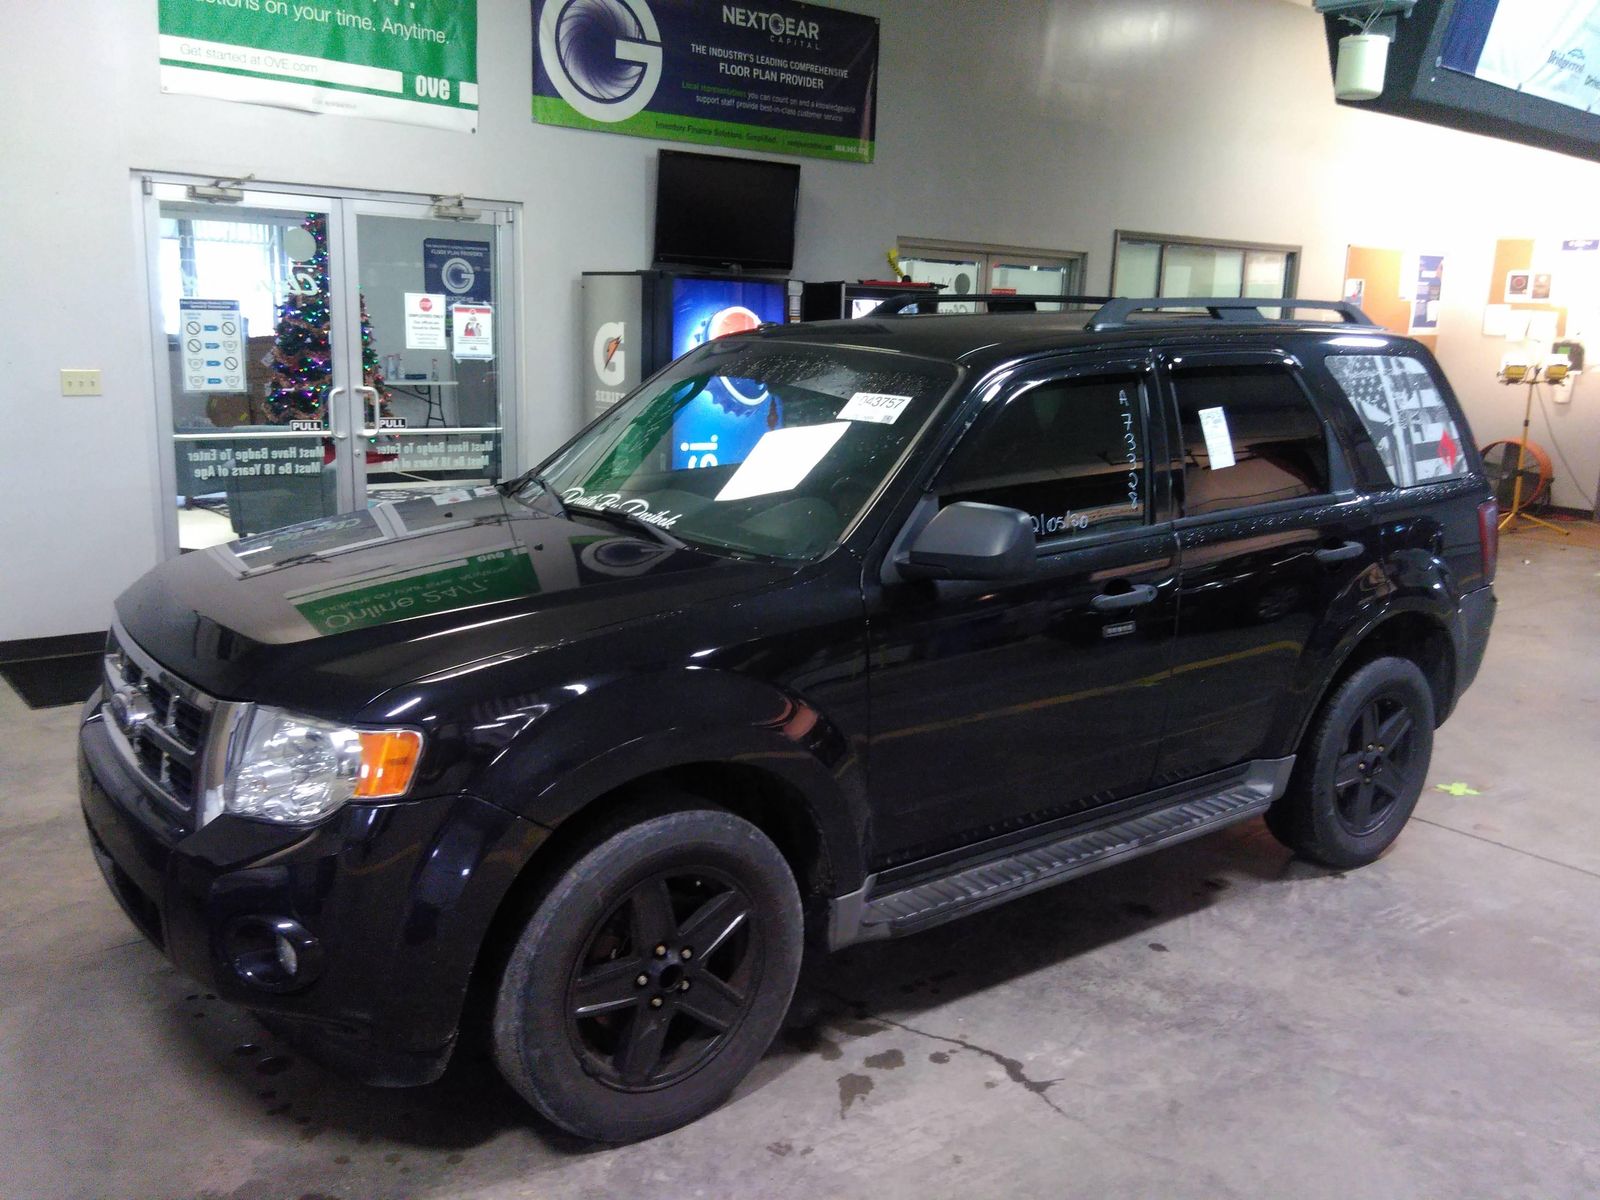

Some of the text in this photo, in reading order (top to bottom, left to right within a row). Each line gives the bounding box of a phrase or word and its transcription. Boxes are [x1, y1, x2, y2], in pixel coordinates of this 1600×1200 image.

[264, 0, 288, 15] on
[292, 4, 332, 23] your
[336, 9, 376, 32] time.
[381, 17, 450, 44] Anytime.
[722, 5, 820, 40] NEXTGEAR
[770, 35, 820, 50] CAPITAL
[180, 43, 201, 56] Get
[205, 48, 247, 64] started
[250, 54, 261, 65] at
[691, 43, 849, 79] THE INDUSTRY'S LEADING COMPREHENSIVE
[719, 62, 824, 89] FLOOR PLAN PROVIDER
[415, 75, 451, 100] ove
[747, 92, 759, 100] you
[695, 95, 720, 105] support
[721, 98, 736, 106] staff
[736, 101, 759, 110] provide
[759, 104, 797, 116] best-in-class
[292, 422, 321, 431] PULL
[379, 419, 405, 428] PULL
